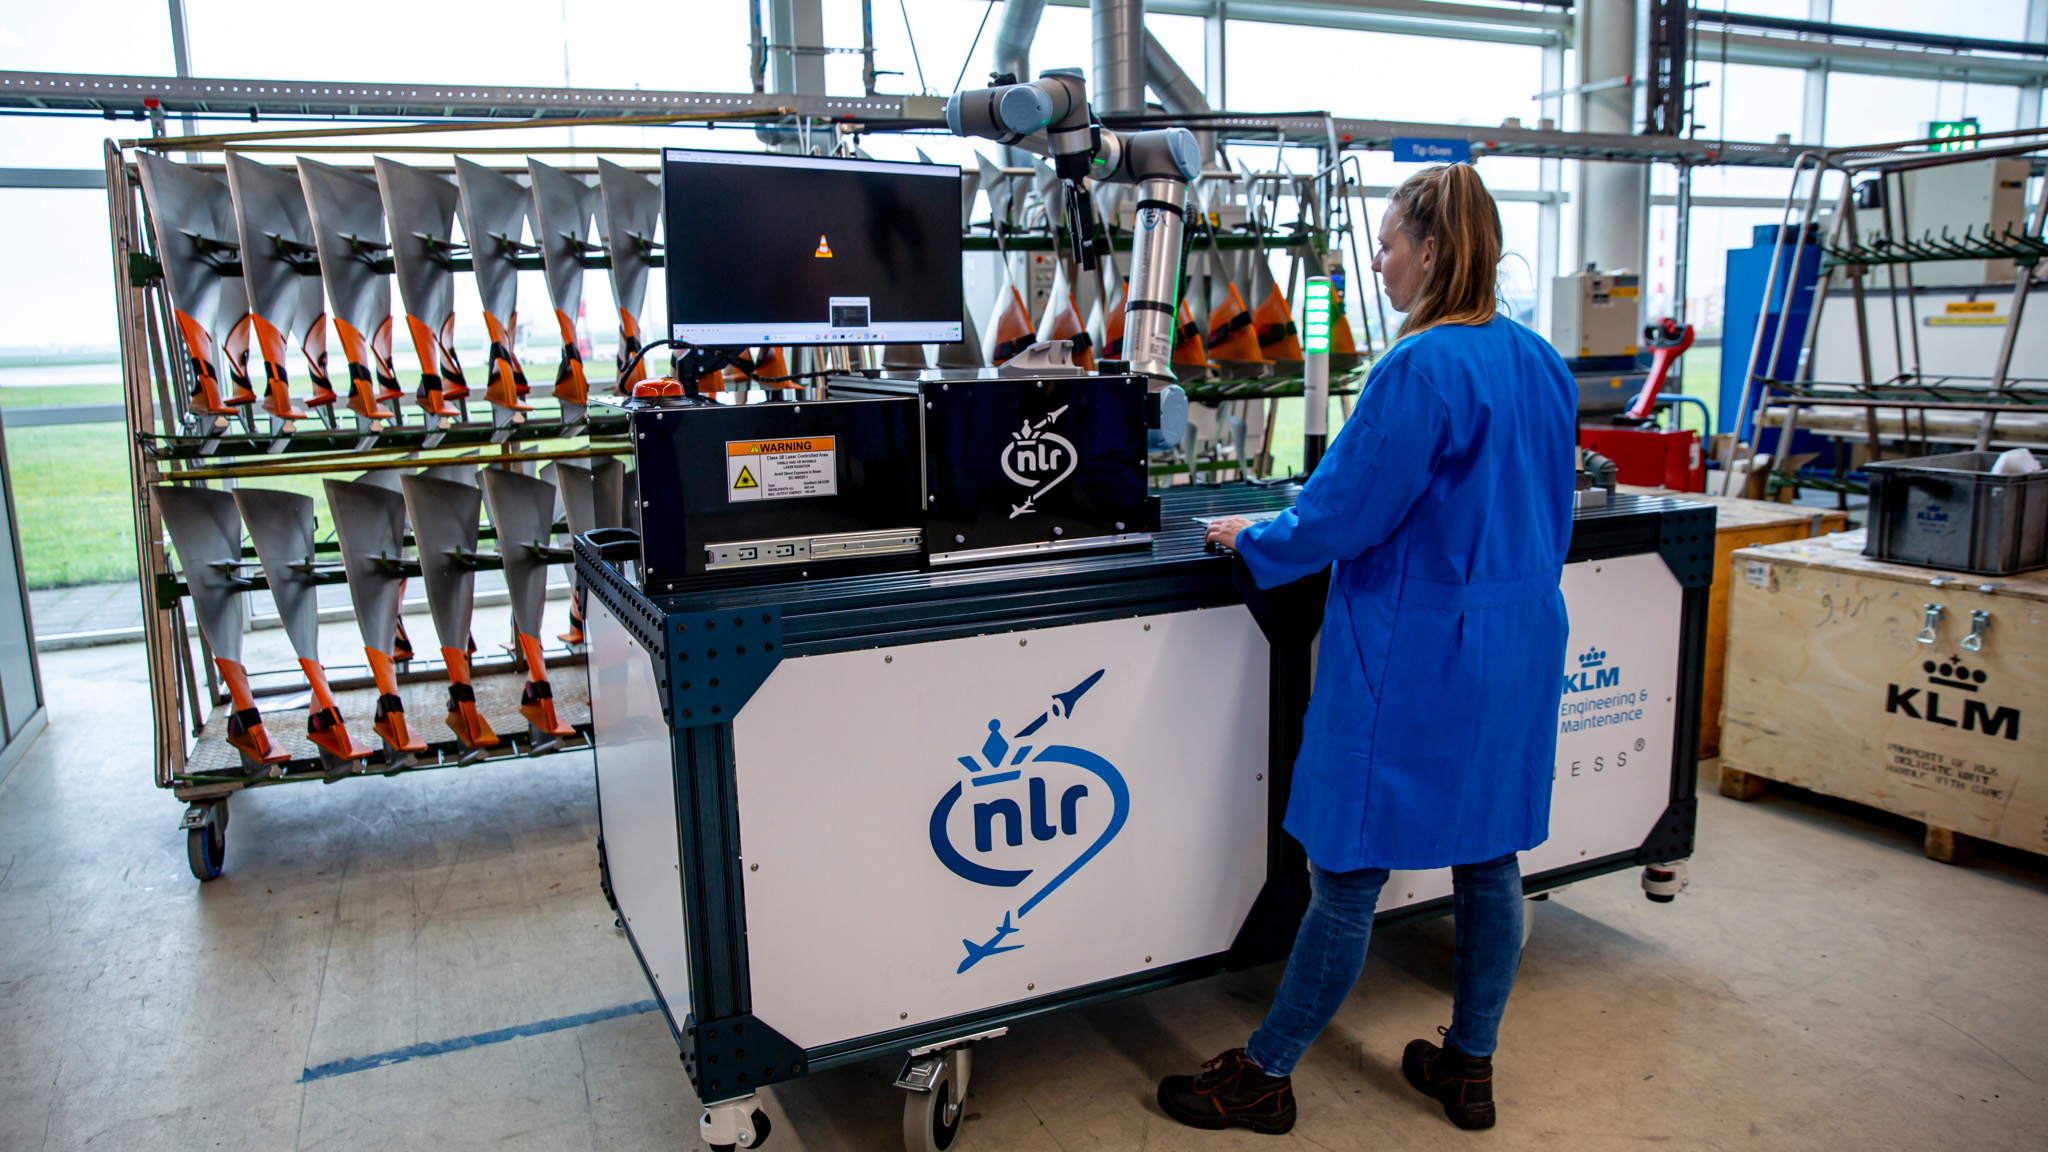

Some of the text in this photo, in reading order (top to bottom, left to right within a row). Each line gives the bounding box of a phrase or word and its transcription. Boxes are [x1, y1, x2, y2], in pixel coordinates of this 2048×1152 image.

[760, 441, 812, 453] WARNING
[1017, 443, 1062, 472] nlr
[1562, 666, 1620, 695] KLM
[1560, 689, 1648, 717] Engineering &
[1885, 683, 2021, 742] KLM
[1560, 708, 1643, 734] Maintenance
[1893, 754, 1953, 777] DELICATE
[973, 776, 1089, 853] nlr
